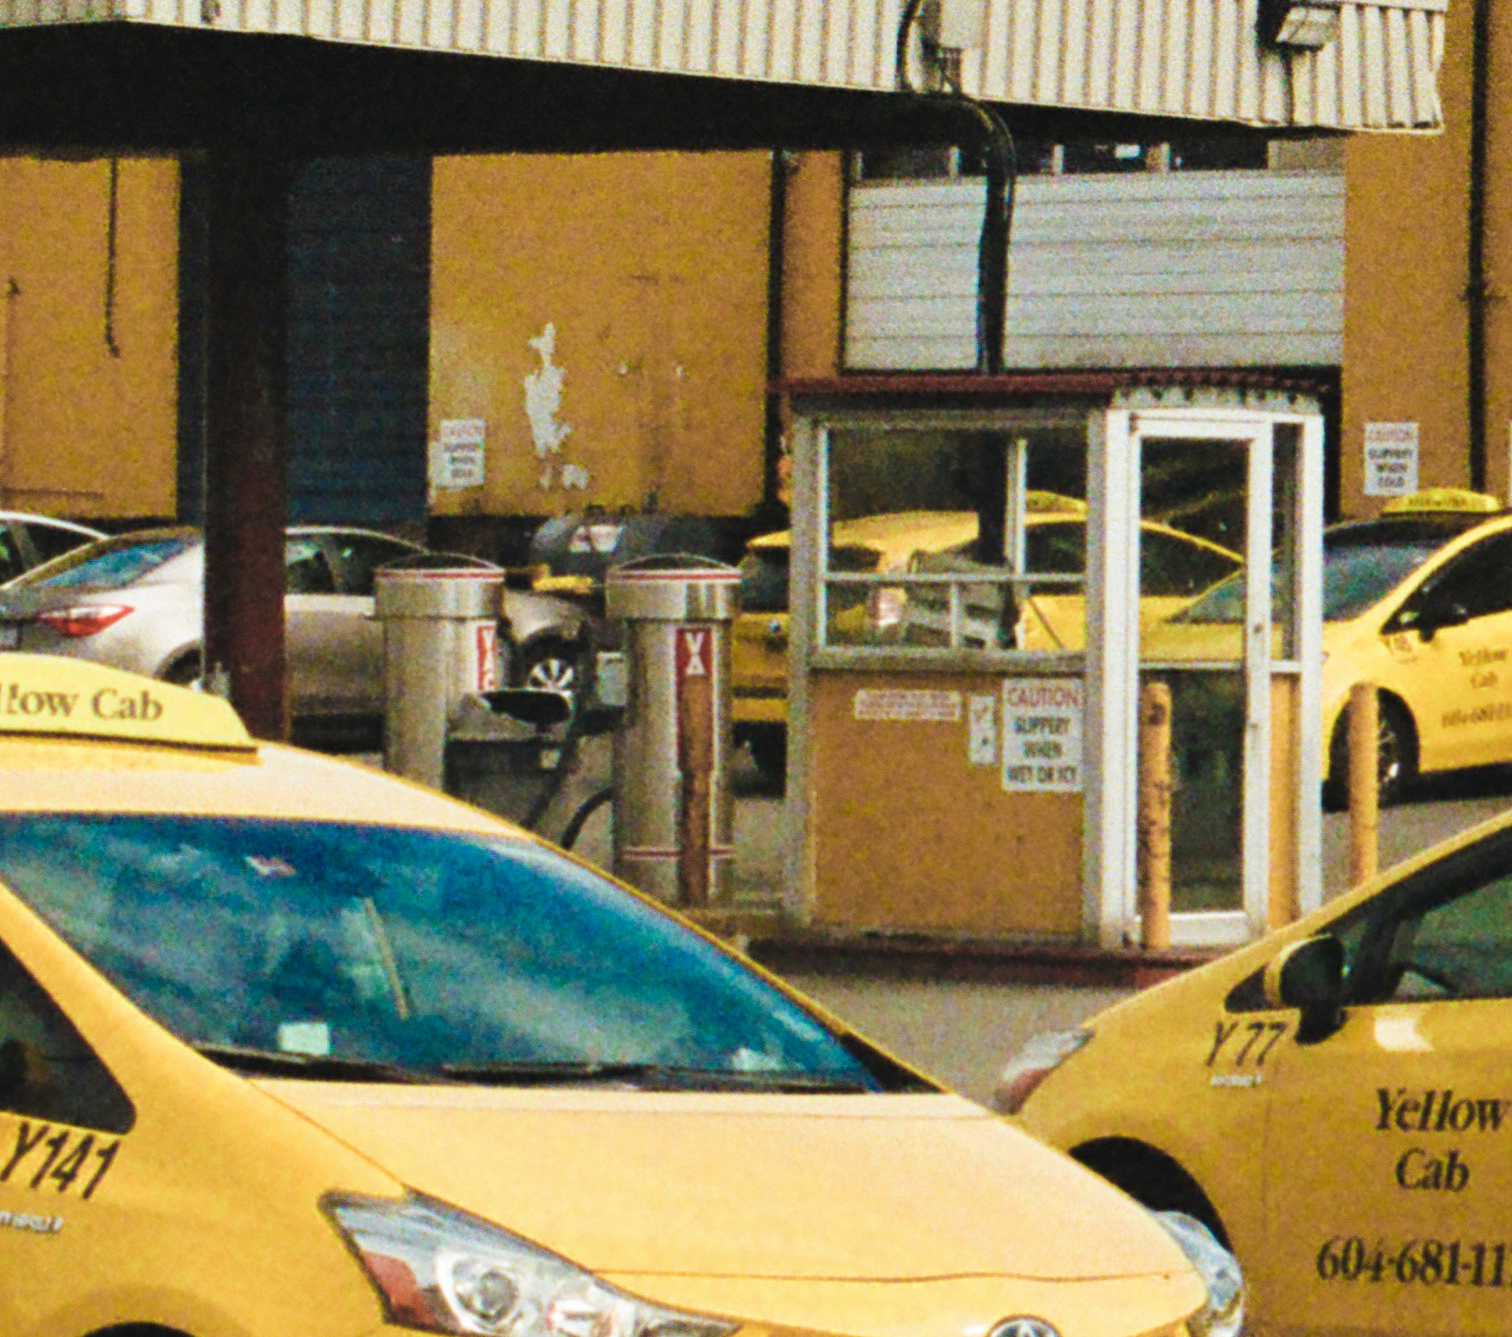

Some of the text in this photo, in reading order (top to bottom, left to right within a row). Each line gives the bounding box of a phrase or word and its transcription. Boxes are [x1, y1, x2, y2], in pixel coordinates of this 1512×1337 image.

[91, 688, 164, 721] Cab
[1006, 686, 1080, 708] CAUTION
[1373, 1087, 1511, 1133] Yellow
[0, 1120, 121, 1201] Y141
[1394, 1148, 1471, 1193] Cab
